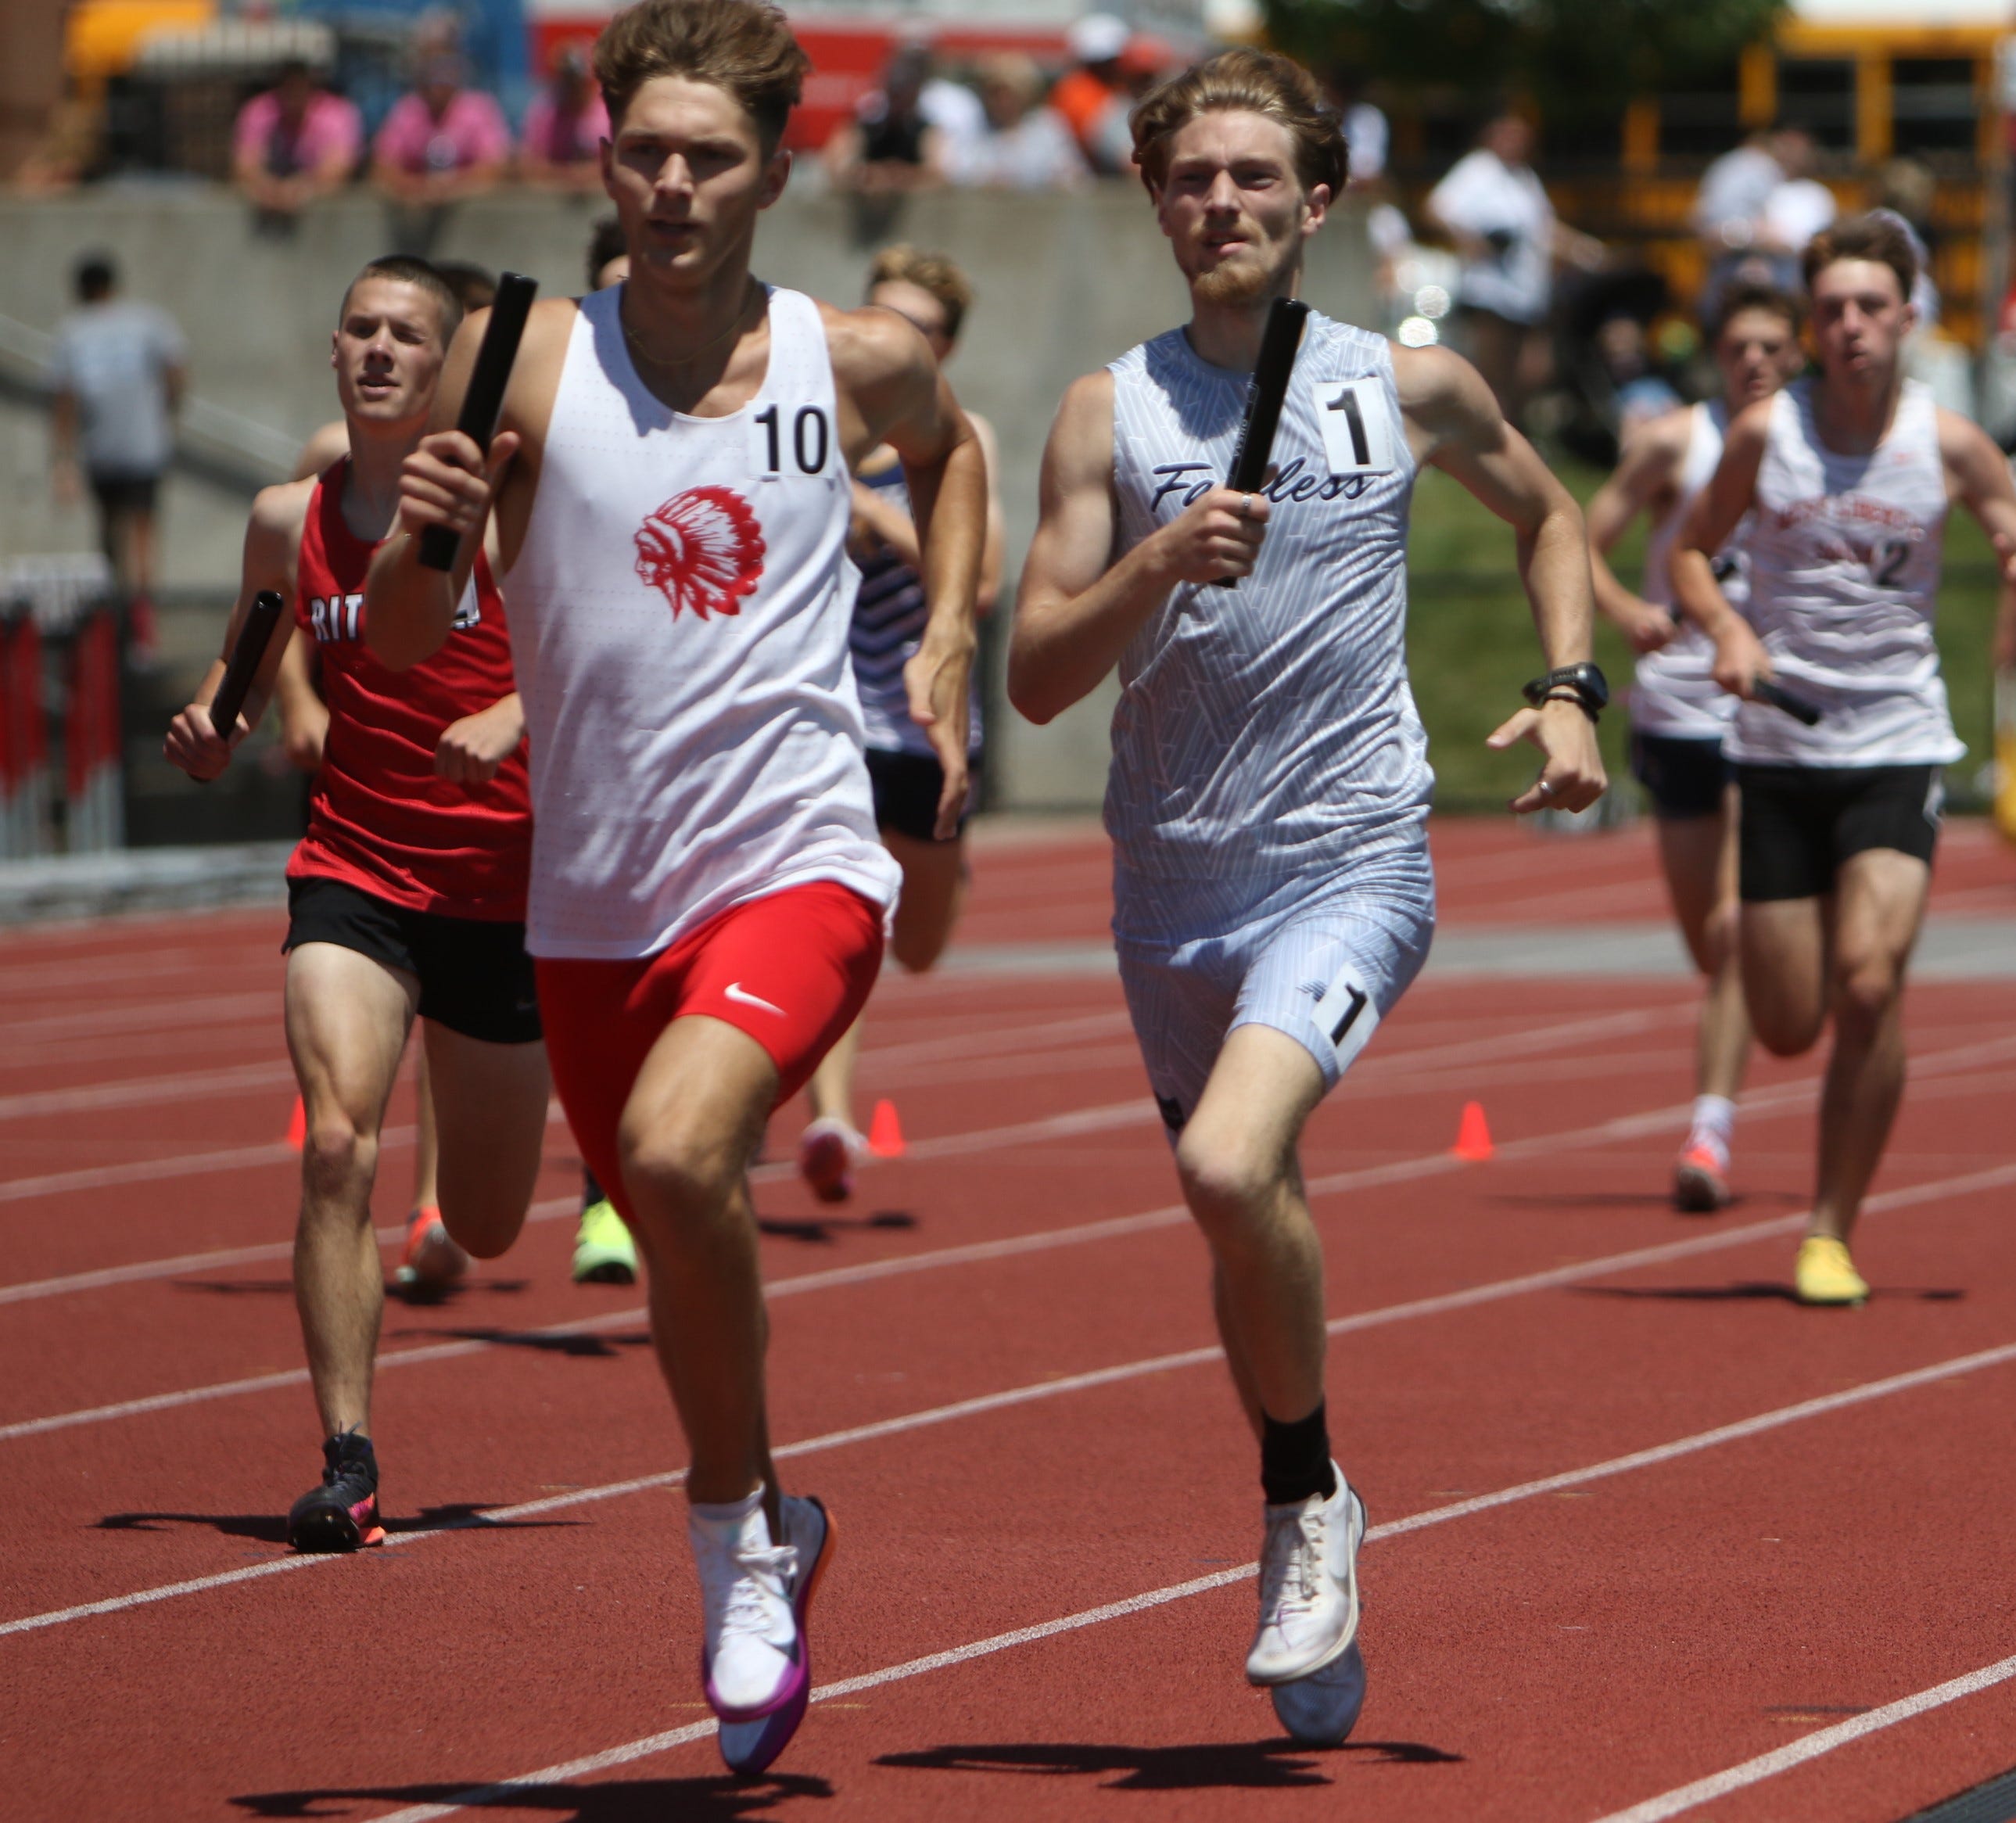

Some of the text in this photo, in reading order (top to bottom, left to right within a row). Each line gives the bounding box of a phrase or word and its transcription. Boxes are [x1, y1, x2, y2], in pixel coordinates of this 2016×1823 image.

[753, 403, 829, 475] 10
[1325, 386, 1372, 465] 1
[1151, 455, 1376, 513] Faless
[1876, 540, 1911, 587] 2
[1329, 981, 1368, 1048] 1
